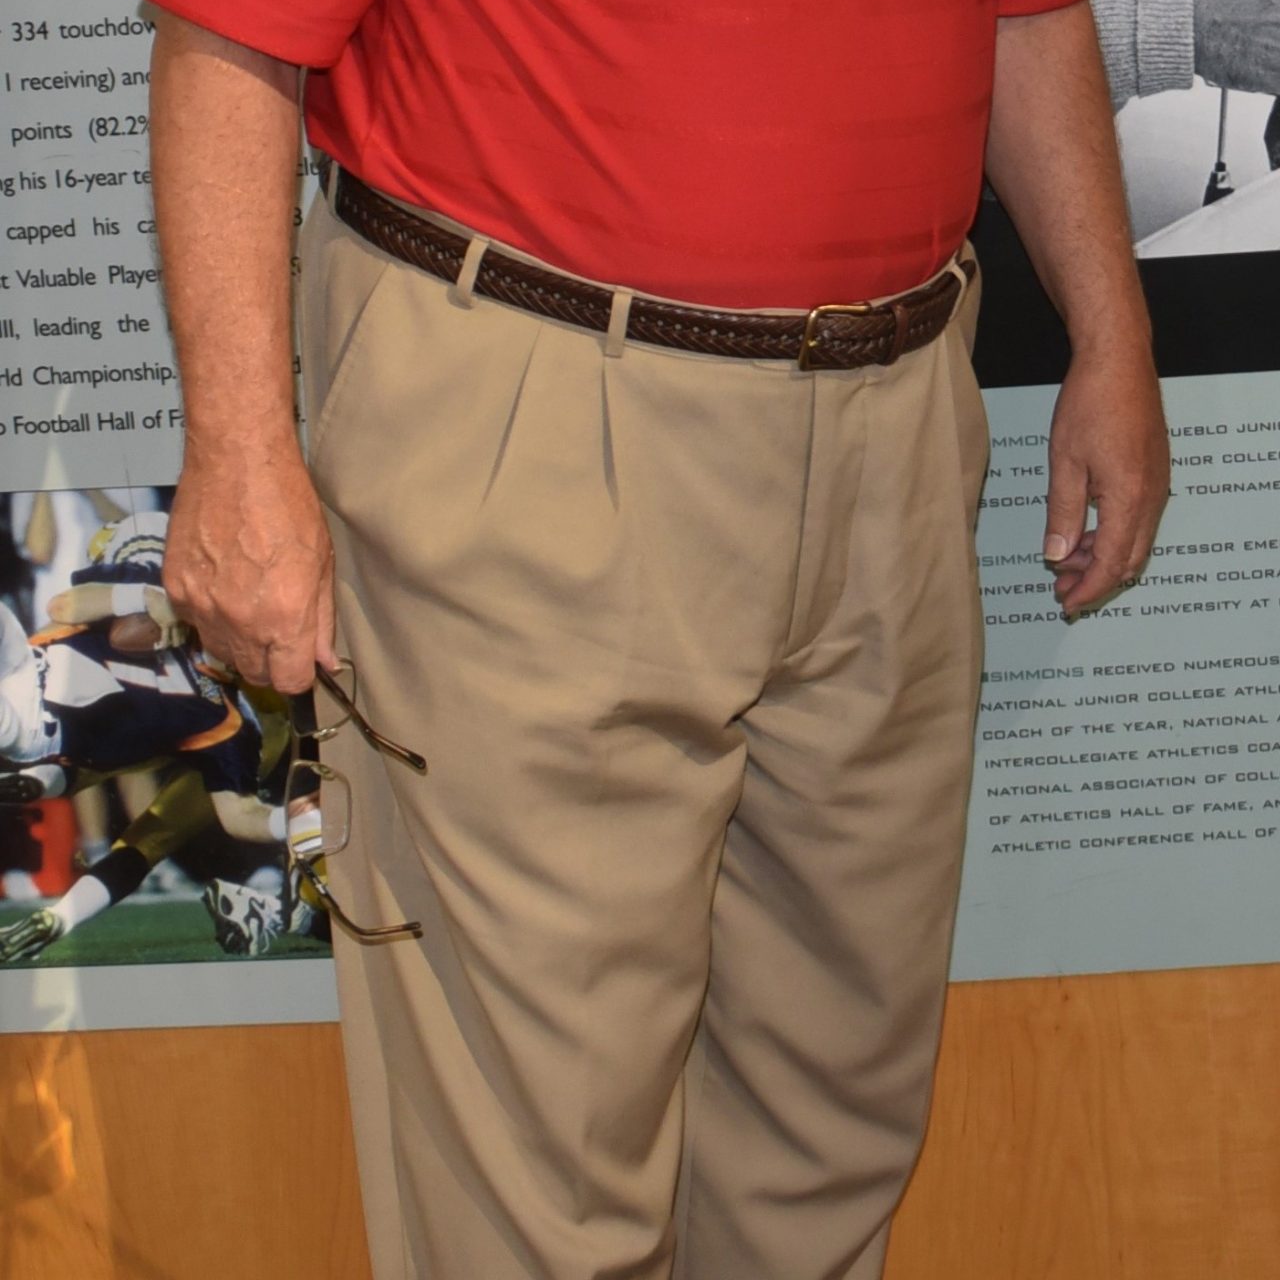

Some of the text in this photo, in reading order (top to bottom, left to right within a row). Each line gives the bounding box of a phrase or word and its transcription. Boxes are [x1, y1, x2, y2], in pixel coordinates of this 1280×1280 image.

[11, 20, 50, 43] 334
[20, 66, 116, 94] receiving)
[32, 361, 177, 390] Championship.
[12, 408, 164, 435] Football Hall of
[1079, 602, 1132, 618] STATE
[1140, 599, 1242, 616] UNIVERSITY
[1249, 598, 1270, 609] AT
[990, 666, 1084, 682] SIMMONS
[1092, 662, 1176, 677] RECEIVED
[1183, 655, 1280, 671] NUMEROUS
[980, 698, 1067, 712] NATIONAL
[1074, 693, 1139, 707] JUNIOR
[1147, 687, 1226, 702] COLLEGE
[985, 750, 1139, 769] INTERCOLLEGIATE
[1146, 744, 1239, 759] ATHLETICS
[986, 783, 1073, 797] NATIONAL
[1080, 775, 1196, 792] ASSOCIATION
[1204, 773, 1227, 785] OF
[991, 839, 1071, 854] ATHLETIC
[1079, 832, 1194, 849] CONFERENCE
[1202, 829, 1247, 841] HALL
[1254, 827, 1277, 838] OF
